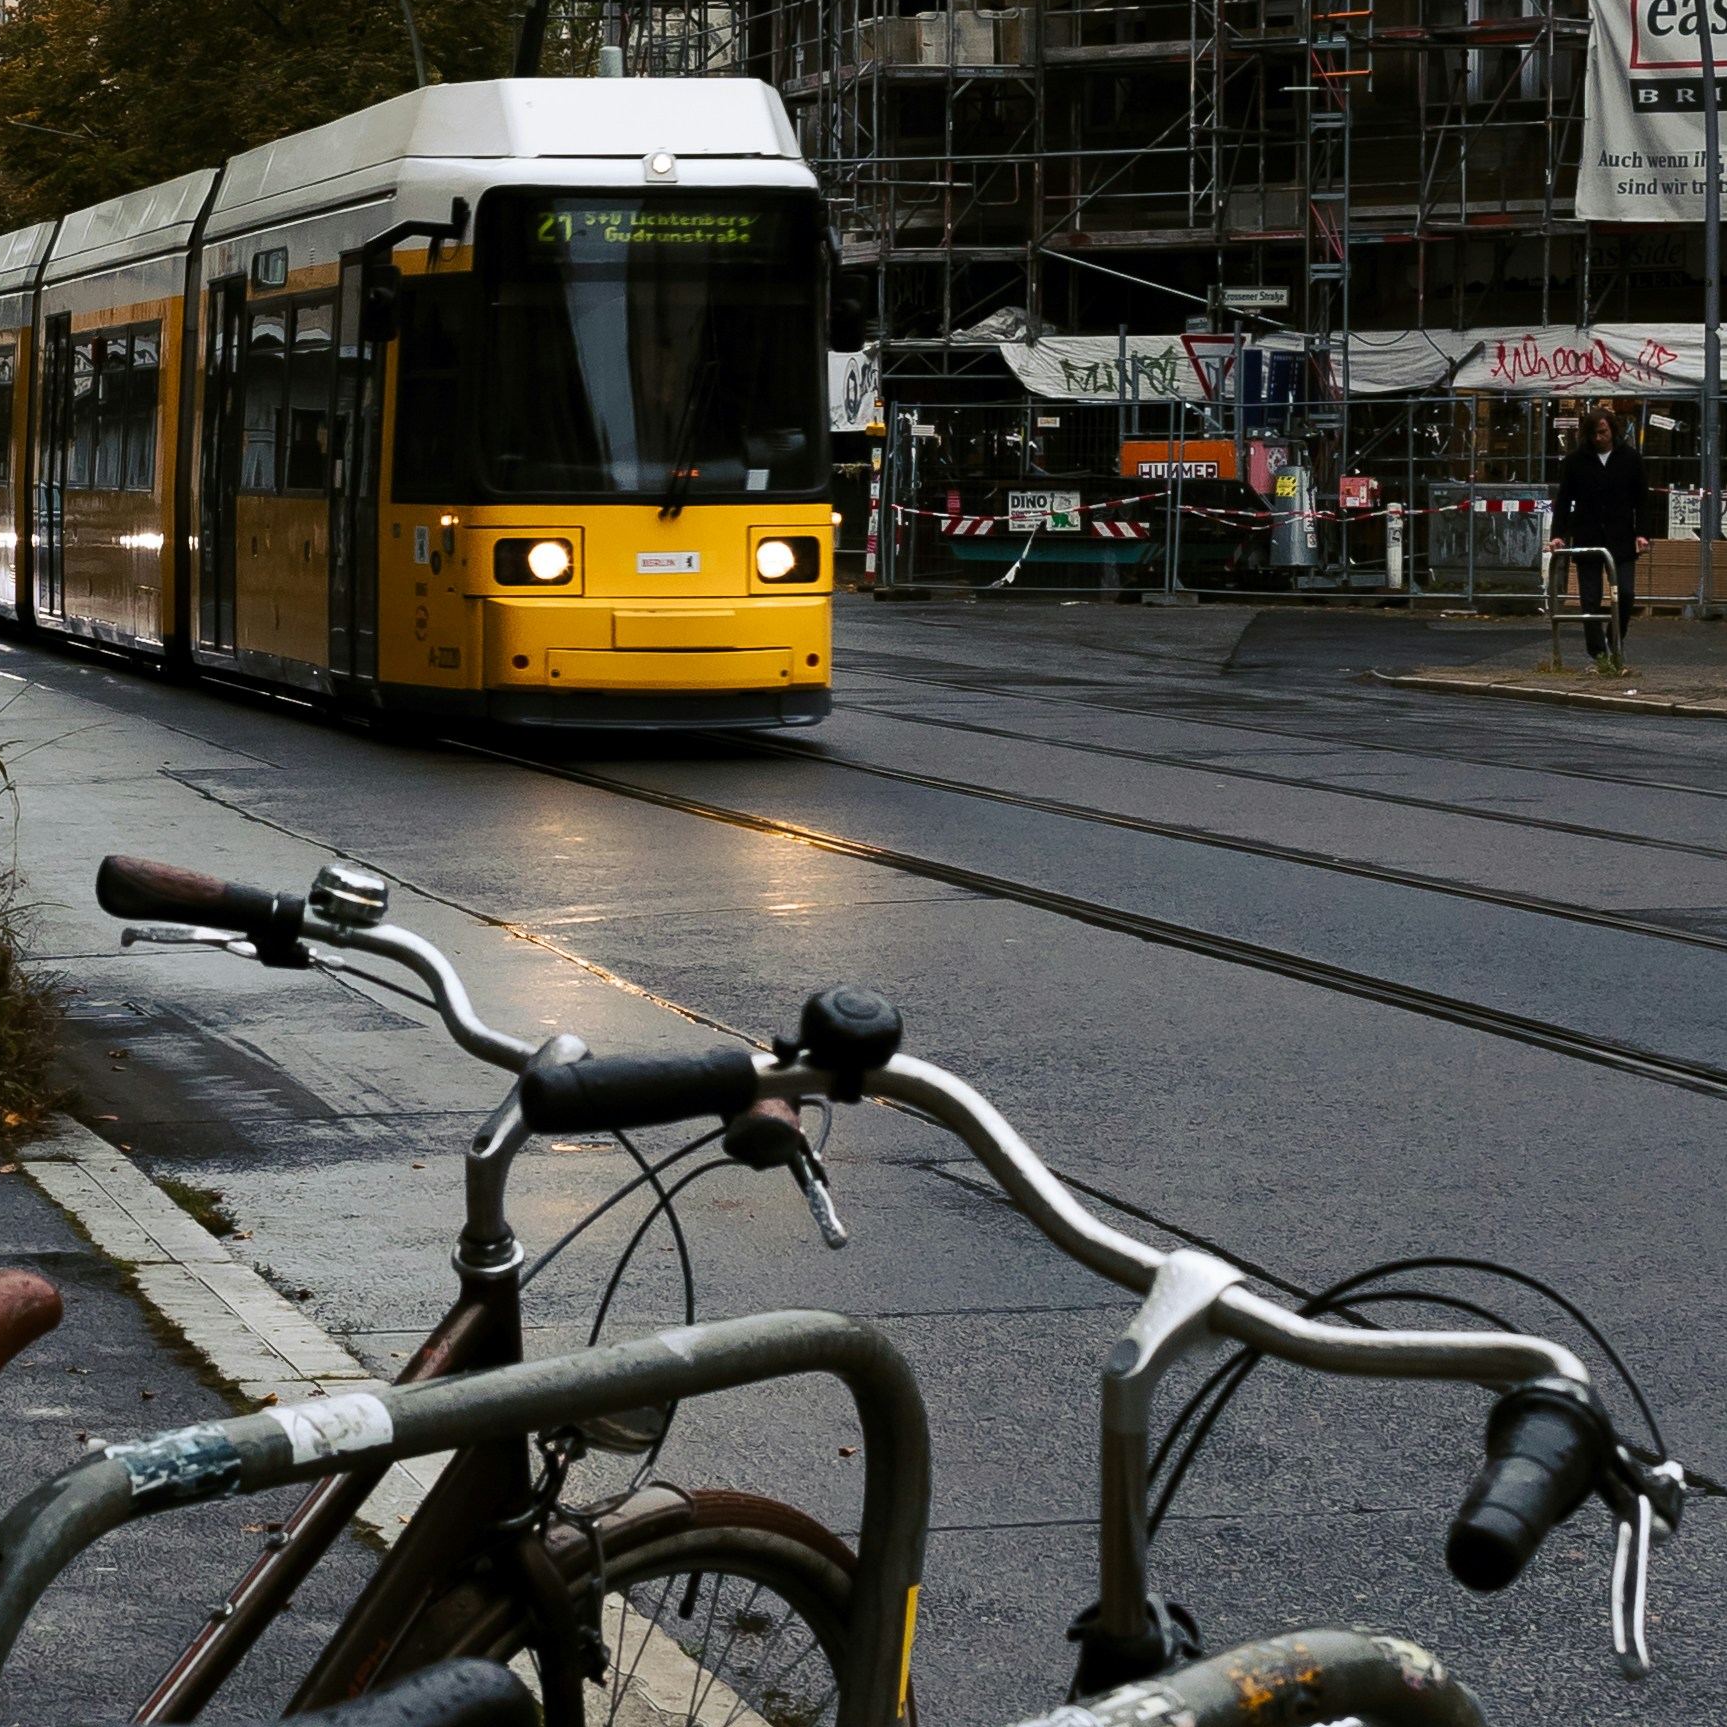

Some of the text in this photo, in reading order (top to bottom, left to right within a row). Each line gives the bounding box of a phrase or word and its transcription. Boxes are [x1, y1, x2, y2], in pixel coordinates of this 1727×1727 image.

[1598, 150, 1642, 169] Auch
[1647, 154, 1690, 169] wenn
[1617, 178, 1658, 195] sind
[1661, 179, 1688, 196] wir
[538, 211, 572, 242] 21
[1139, 462, 1218, 479] HUMMER
[1011, 494, 1048, 509] DINO
